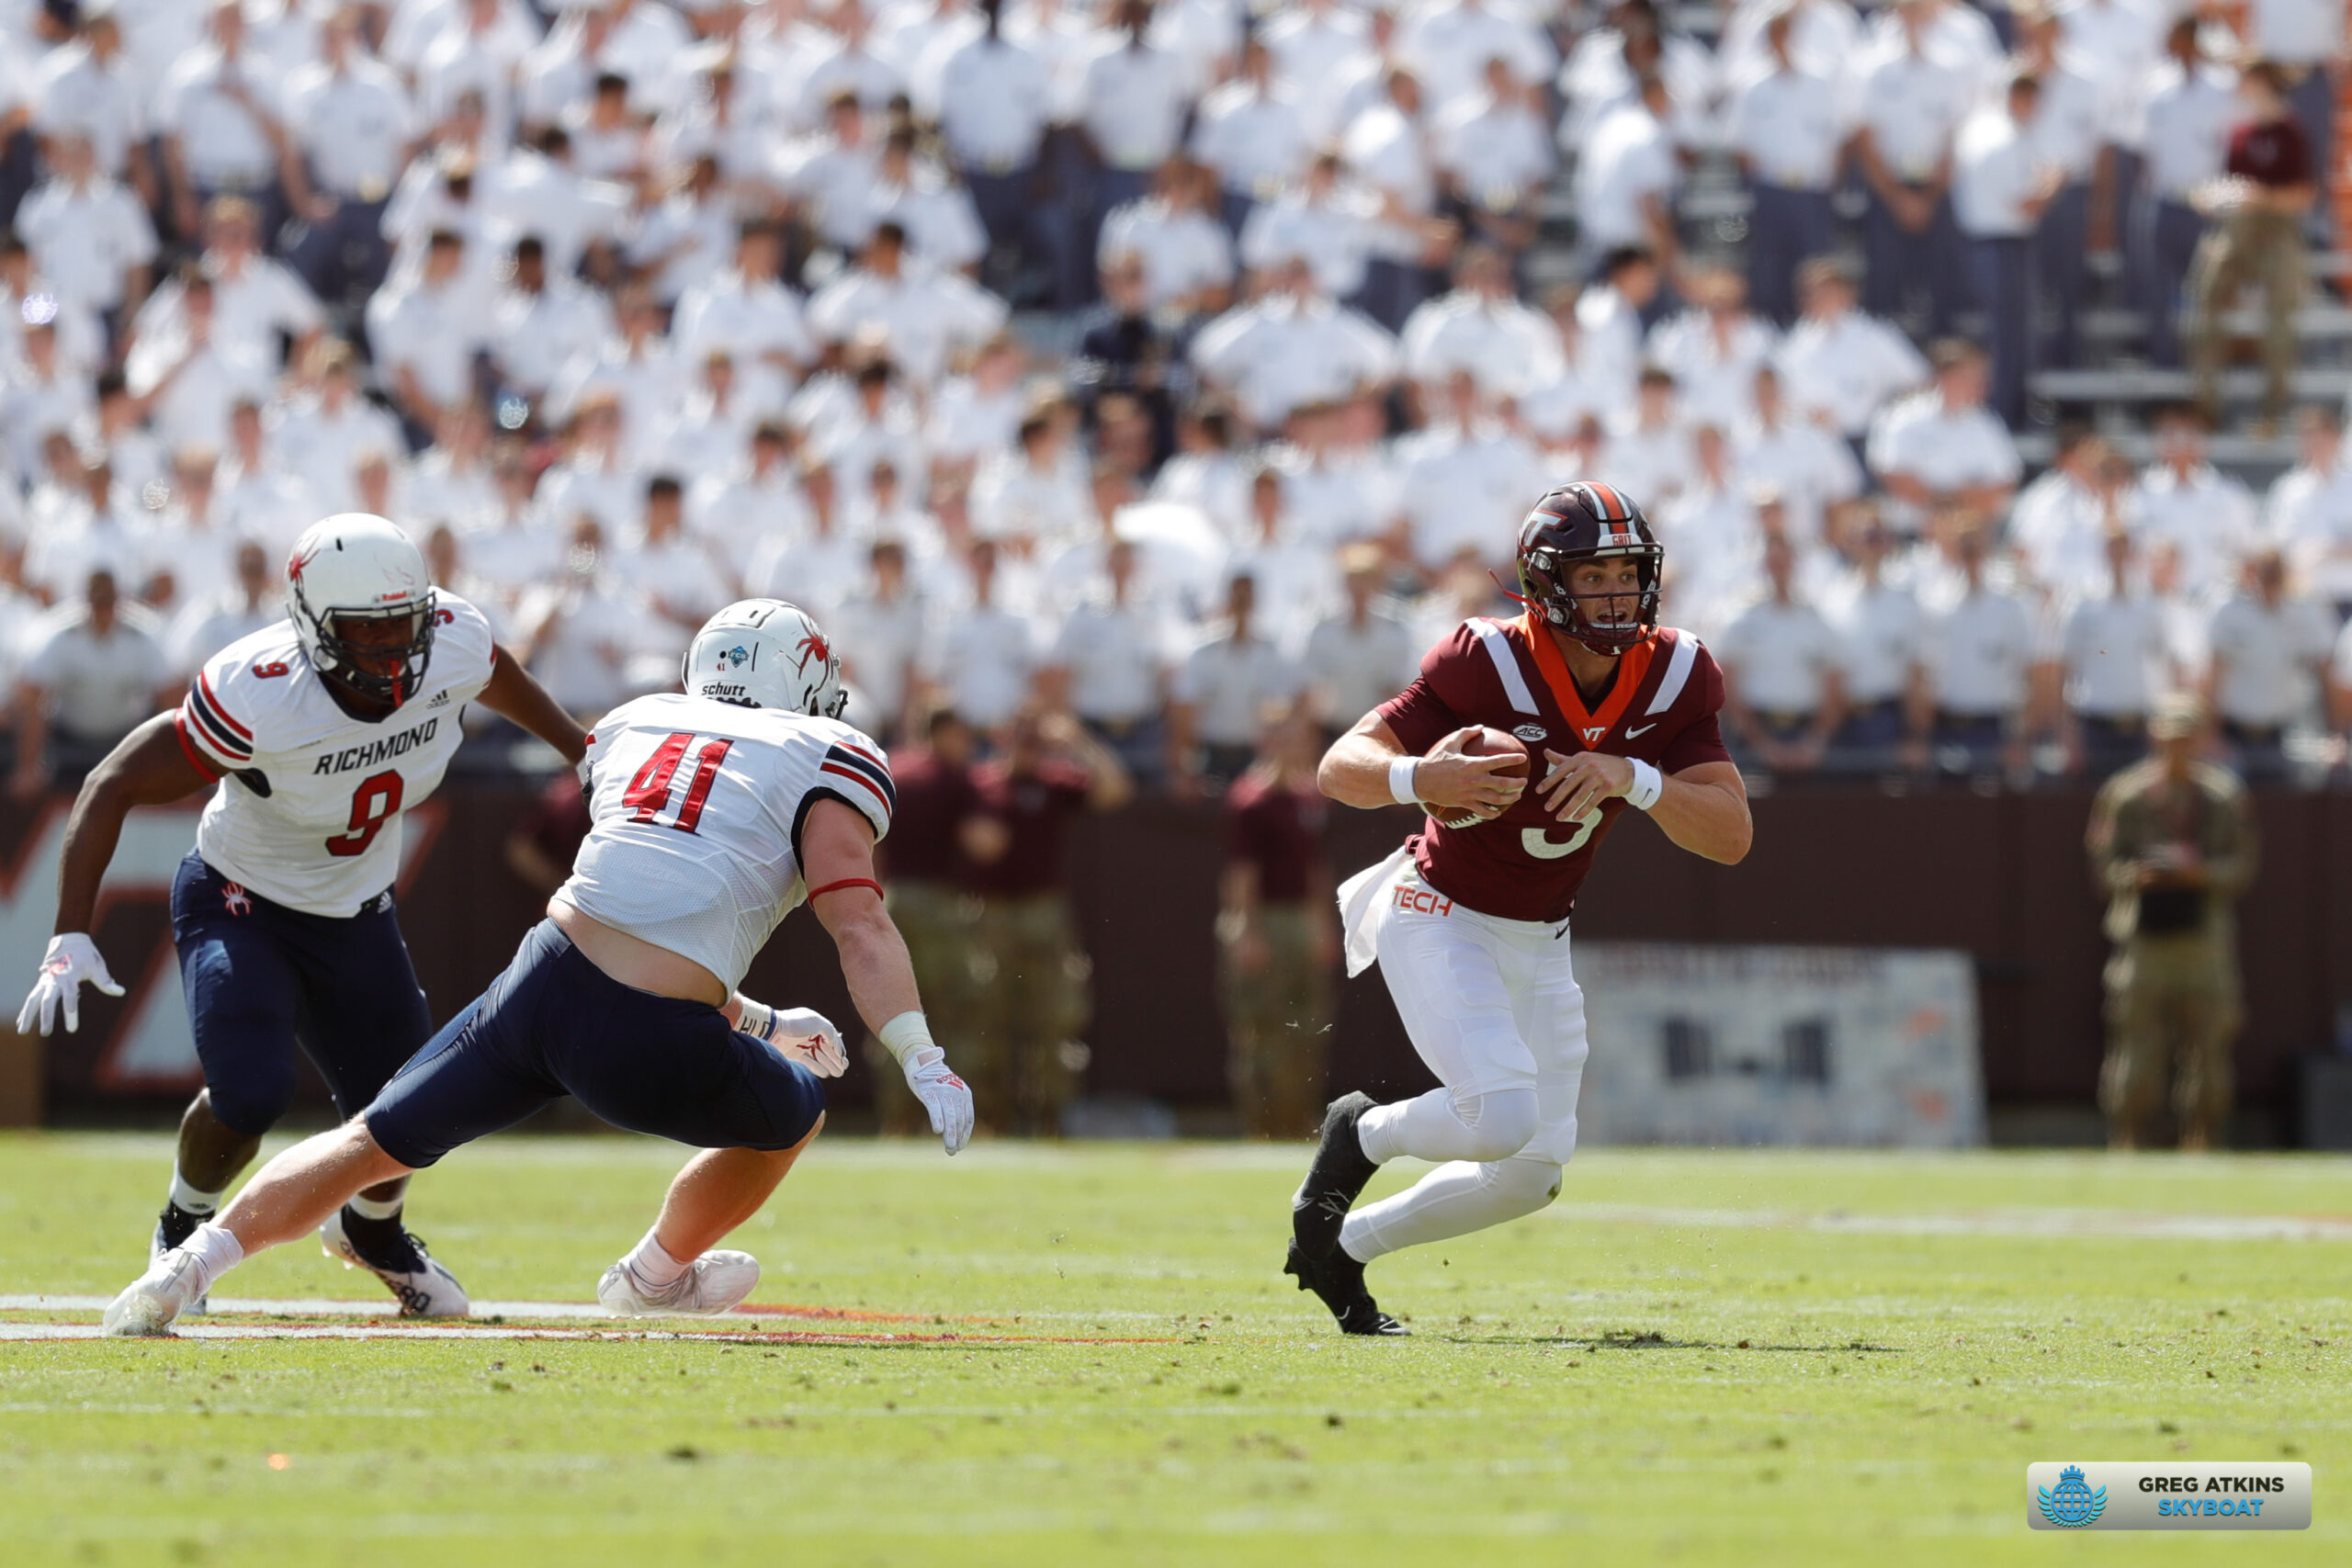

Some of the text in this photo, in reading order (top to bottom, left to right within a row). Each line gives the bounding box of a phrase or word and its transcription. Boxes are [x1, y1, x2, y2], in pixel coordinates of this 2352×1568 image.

[1612, 535, 1632, 547] GRIT
[252, 660, 290, 680] 9
[717, 662, 726, 671] 41
[701, 681, 746, 697] schutt
[1516, 727, 1544, 739] ACC
[1583, 727, 1607, 742] VT
[311, 716, 439, 775] RICHMOND
[622, 731, 735, 837] 41
[324, 768, 405, 857] 9
[1392, 885, 1453, 917] TECH
